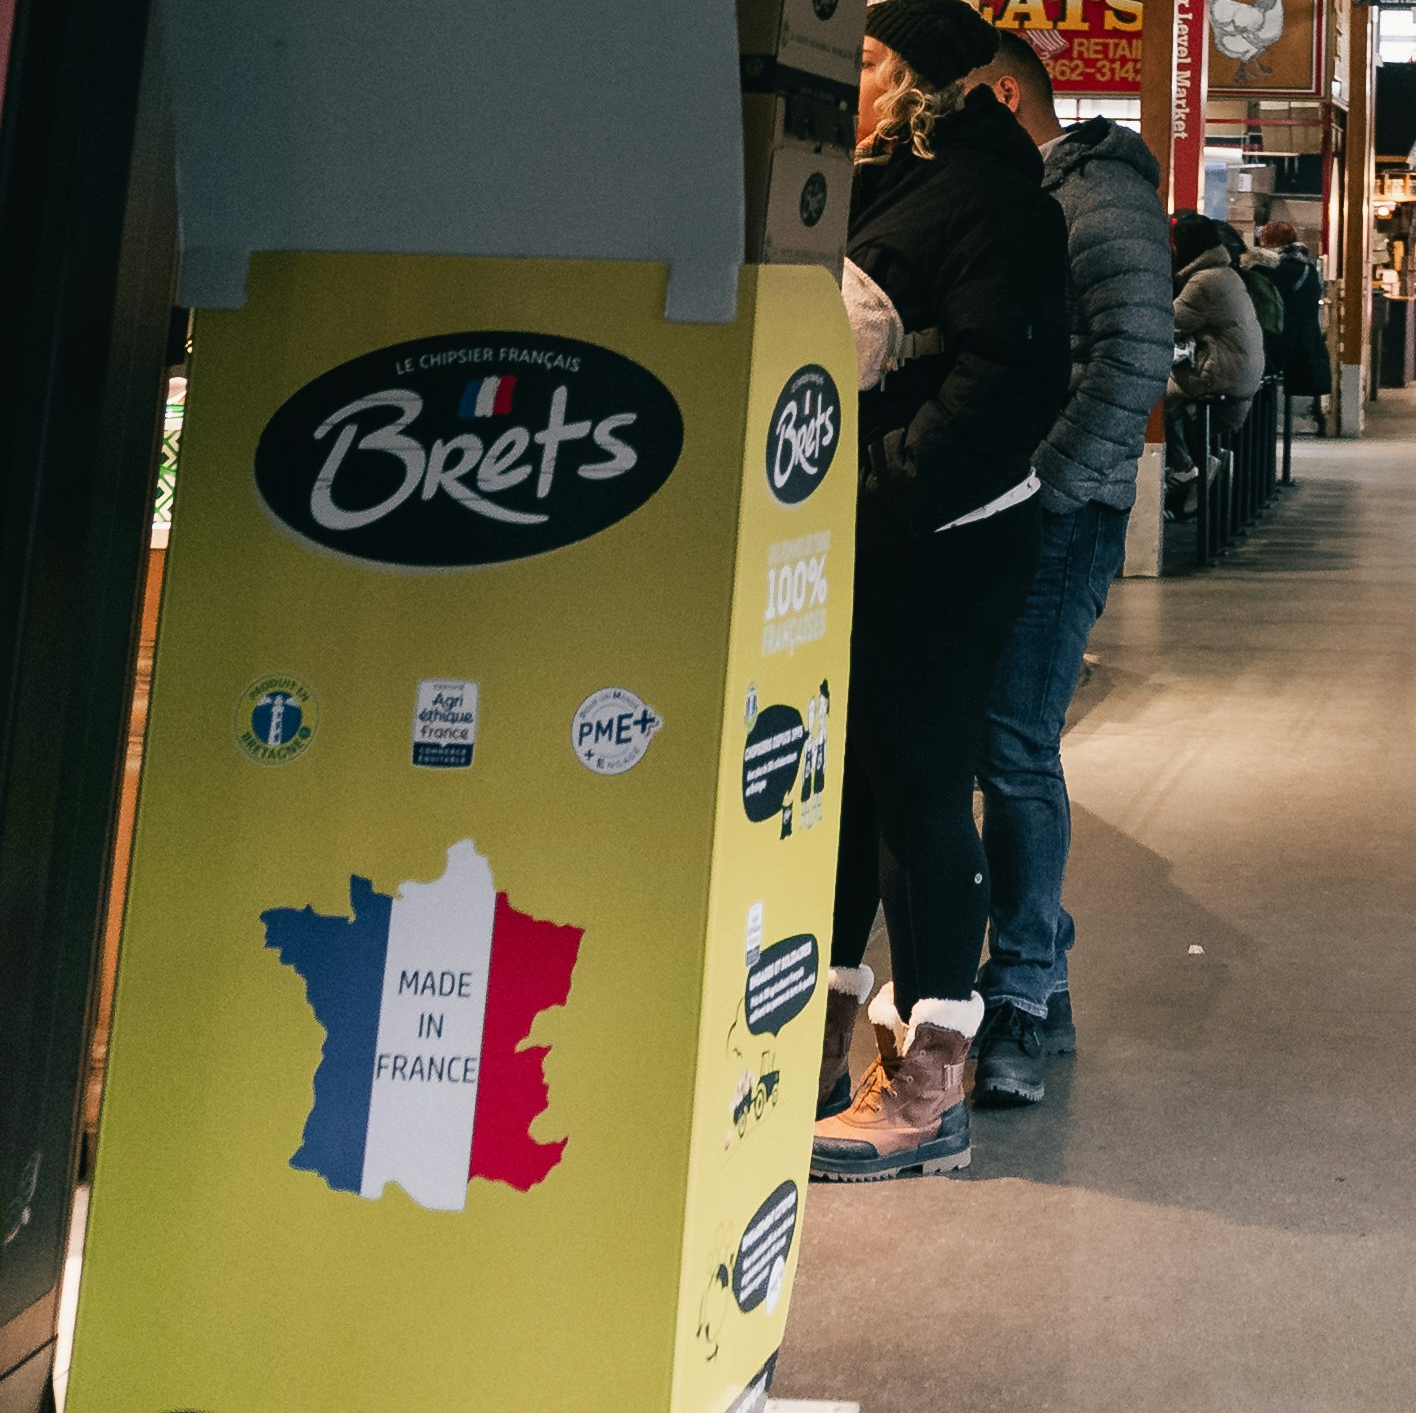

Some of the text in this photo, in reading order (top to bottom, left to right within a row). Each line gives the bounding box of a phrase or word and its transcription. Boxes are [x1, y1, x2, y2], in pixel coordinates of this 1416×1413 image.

[1174, 10, 1193, 65] Level
[1170, 67, 1191, 141] Market
[395, 347, 582, 375] LE CHIPSIER FRANÇAIS
[310, 381, 638, 532] Brets
[773, 390, 835, 489] Brets
[765, 553, 827, 622] 100%
[432, 693, 463, 711] Agri
[398, 970, 473, 999] MADE
[417, 1011, 445, 1042] IN
[375, 1054, 478, 1085] FRANCE
